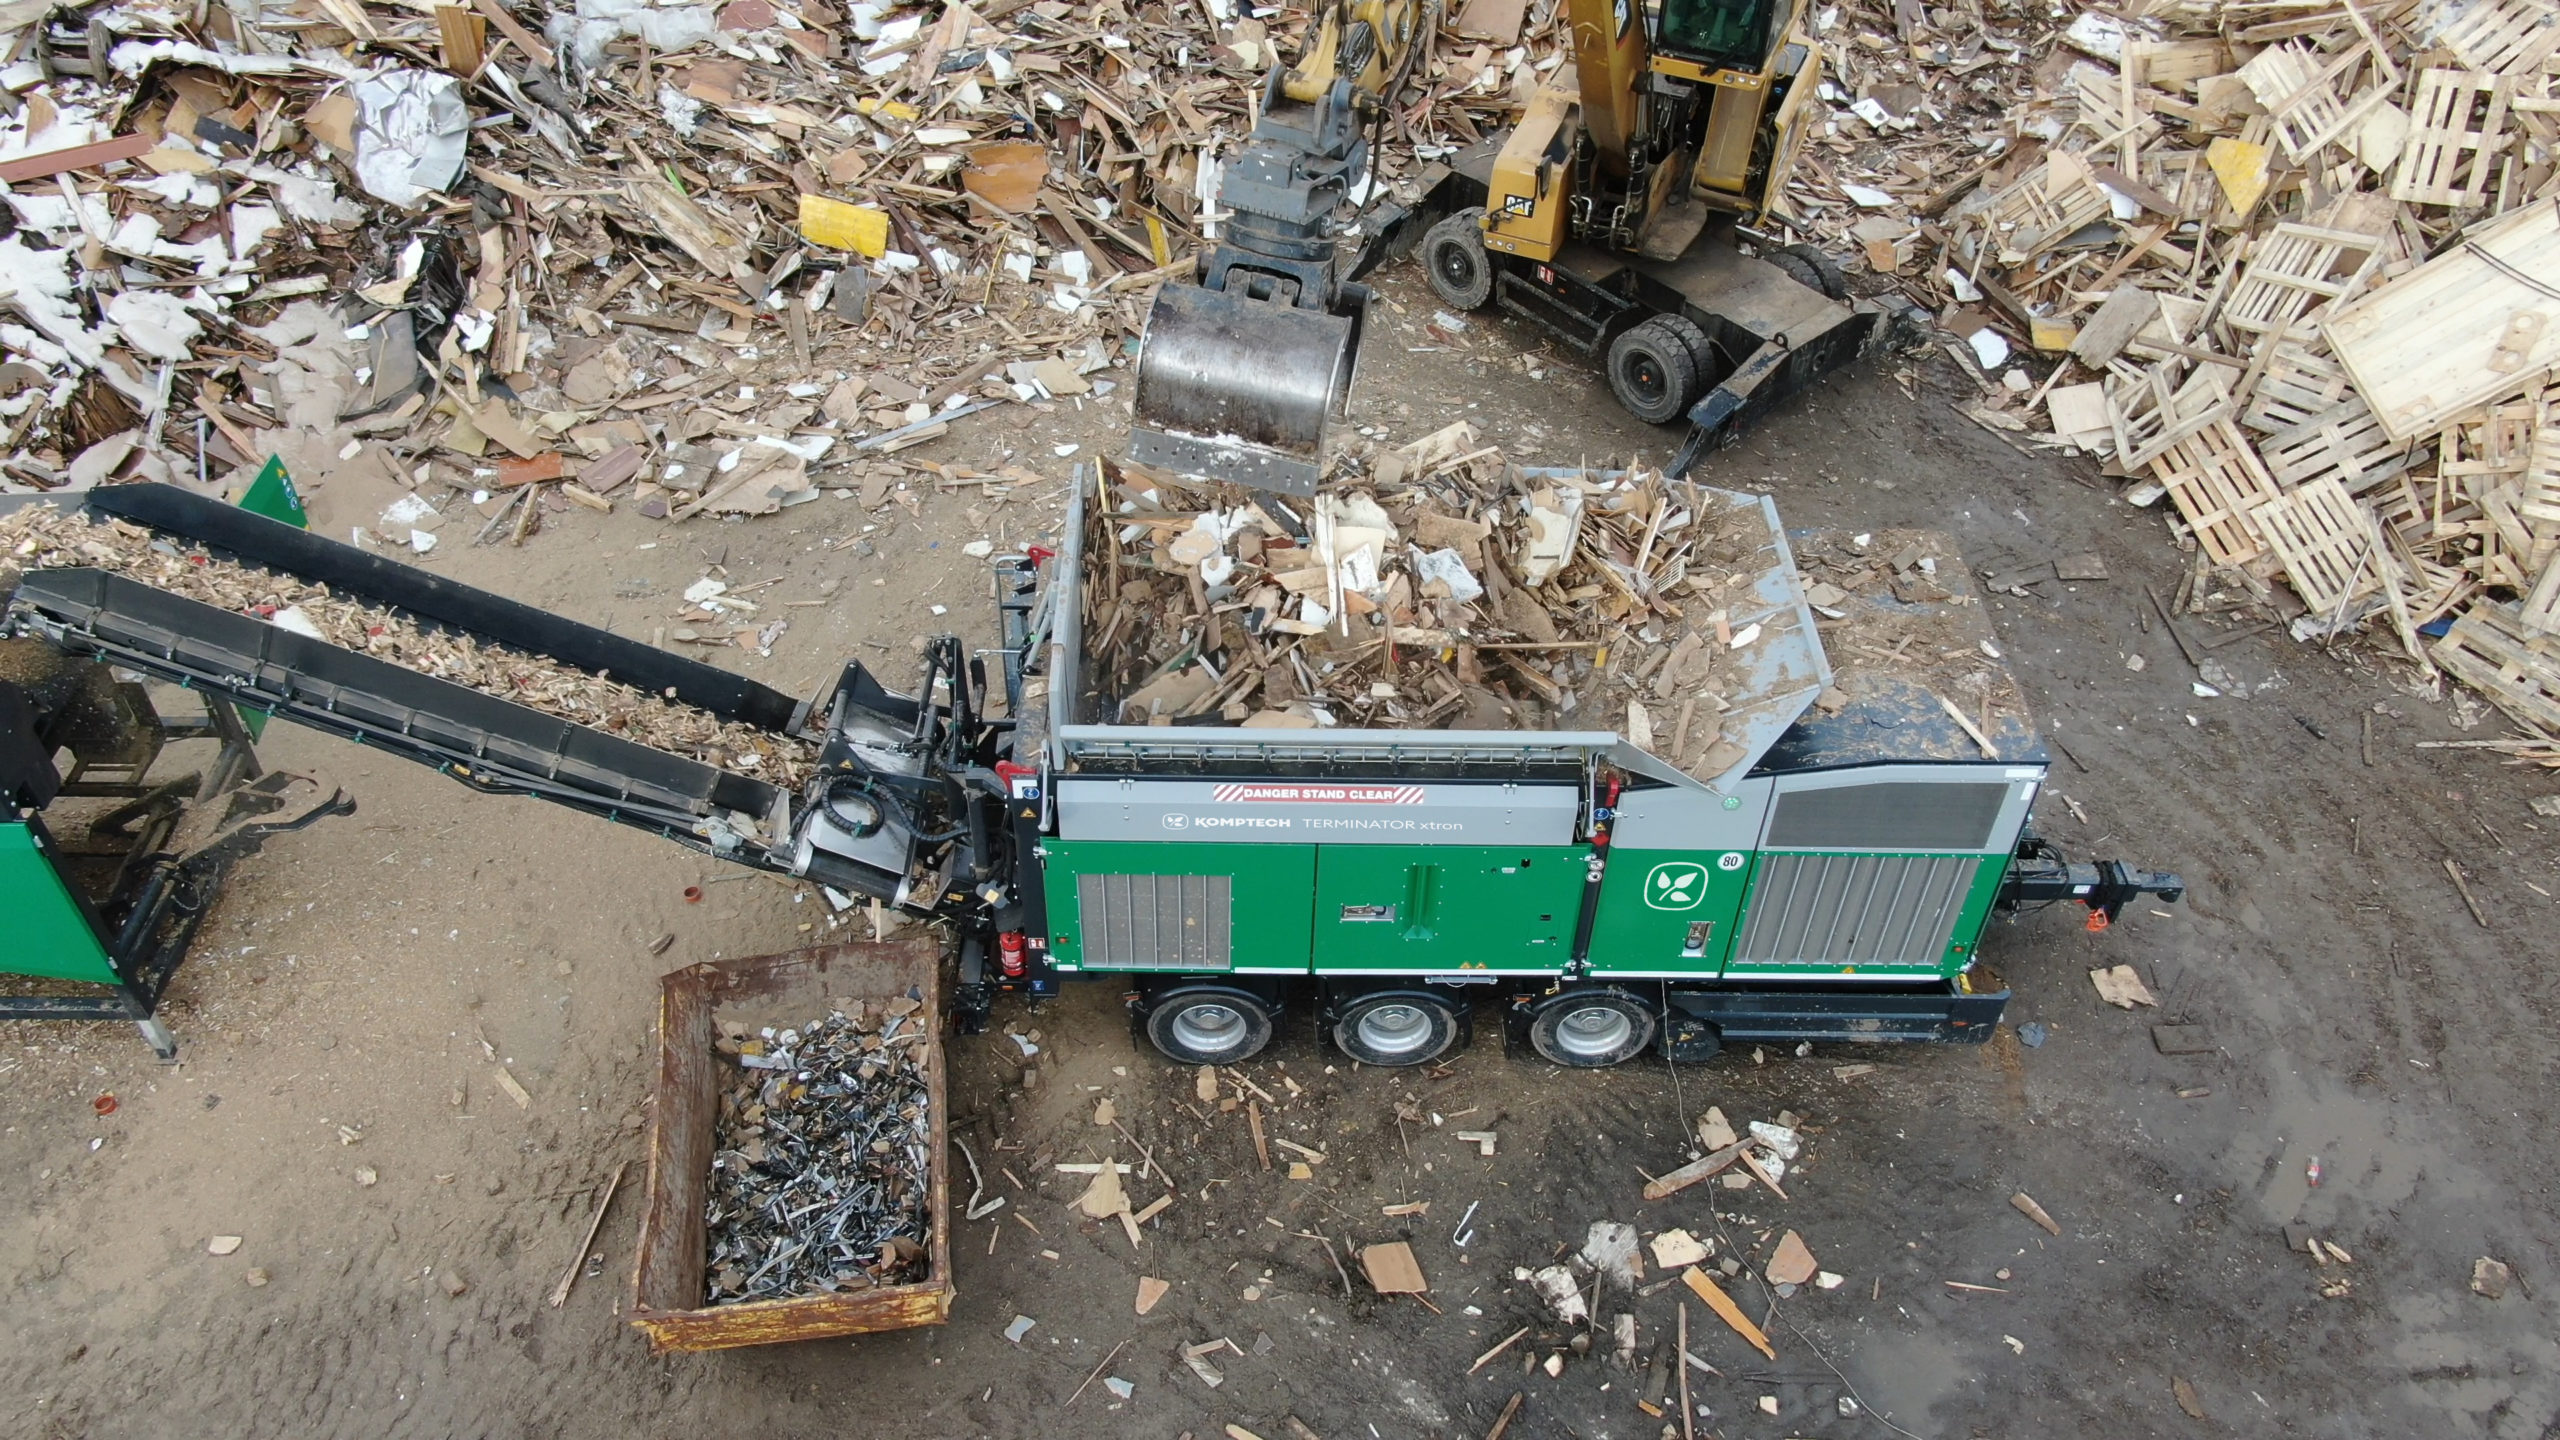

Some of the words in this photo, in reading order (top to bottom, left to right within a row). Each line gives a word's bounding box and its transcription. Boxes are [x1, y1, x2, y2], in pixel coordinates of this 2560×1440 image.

[1506, 196, 1532, 216] CAT
[1243, 788, 1299, 799] DANGER
[1302, 789, 1345, 799] STAND
[1349, 790, 1393, 800] CLEAR
[1194, 817, 1291, 828] KOMPTECH
[1302, 818, 1416, 830] TERMINATOR
[1420, 821, 1463, 831] xtron
[1723, 856, 1738, 867] 80
